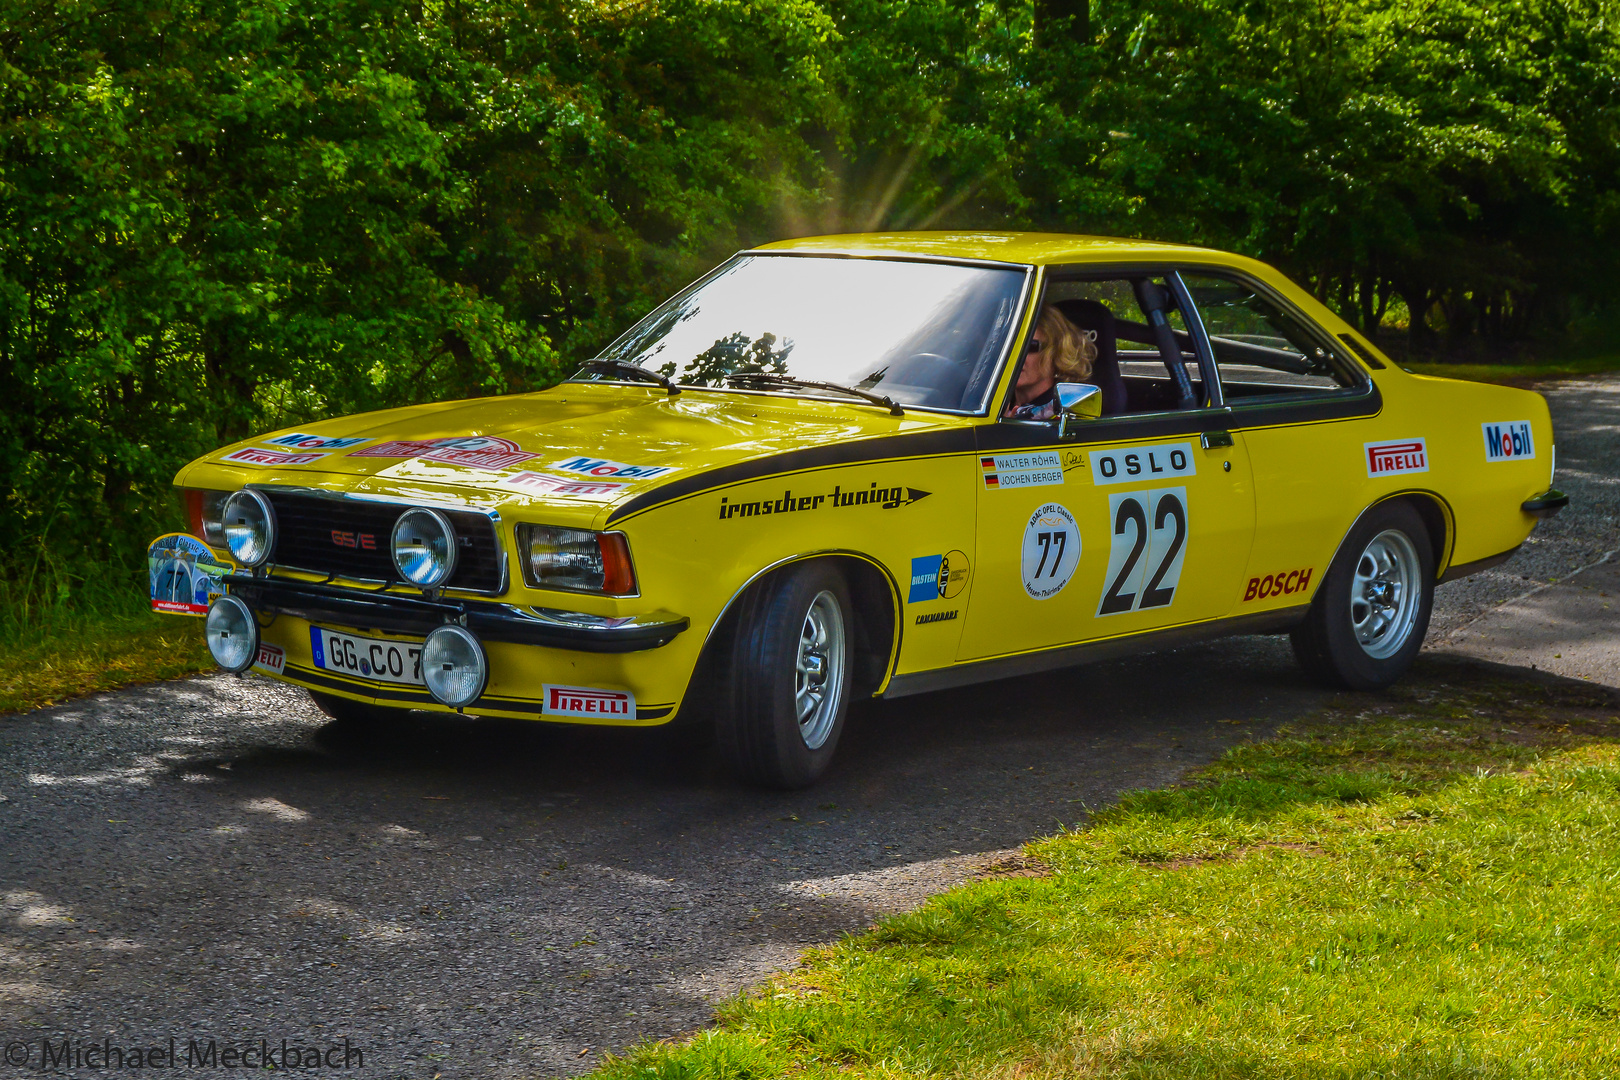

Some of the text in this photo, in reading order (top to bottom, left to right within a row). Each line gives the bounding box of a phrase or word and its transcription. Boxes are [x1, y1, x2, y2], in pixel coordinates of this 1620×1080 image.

[1486, 424, 1532, 458] Mobil
[229, 448, 325, 464] PIRELLI
[560, 457, 670, 478] Mobil
[997, 458, 1030, 469] WALTER
[1032, 455, 1060, 466] RÖHRL
[1100, 450, 1187, 478] OSLO
[1368, 442, 1425, 473] PIRELLI
[508, 472, 622, 495] PIRELLI
[1001, 472, 1063, 485] JOCHEN BERGER
[719, 482, 905, 520] irmscher tuning
[1029, 505, 1074, 528] ADAC OPEL Classic
[178, 537, 200, 554] Classic
[331, 530, 377, 550] GS/E
[1034, 531, 1067, 579] 77
[1099, 493, 1186, 616] 22
[166, 570, 185, 589] 77
[911, 572, 937, 586] BILSTEIN
[1243, 568, 1313, 602] BOSCH
[329, 636, 359, 672] GG
[368, 645, 404, 677] CO
[549, 688, 628, 714] PIRELLI
